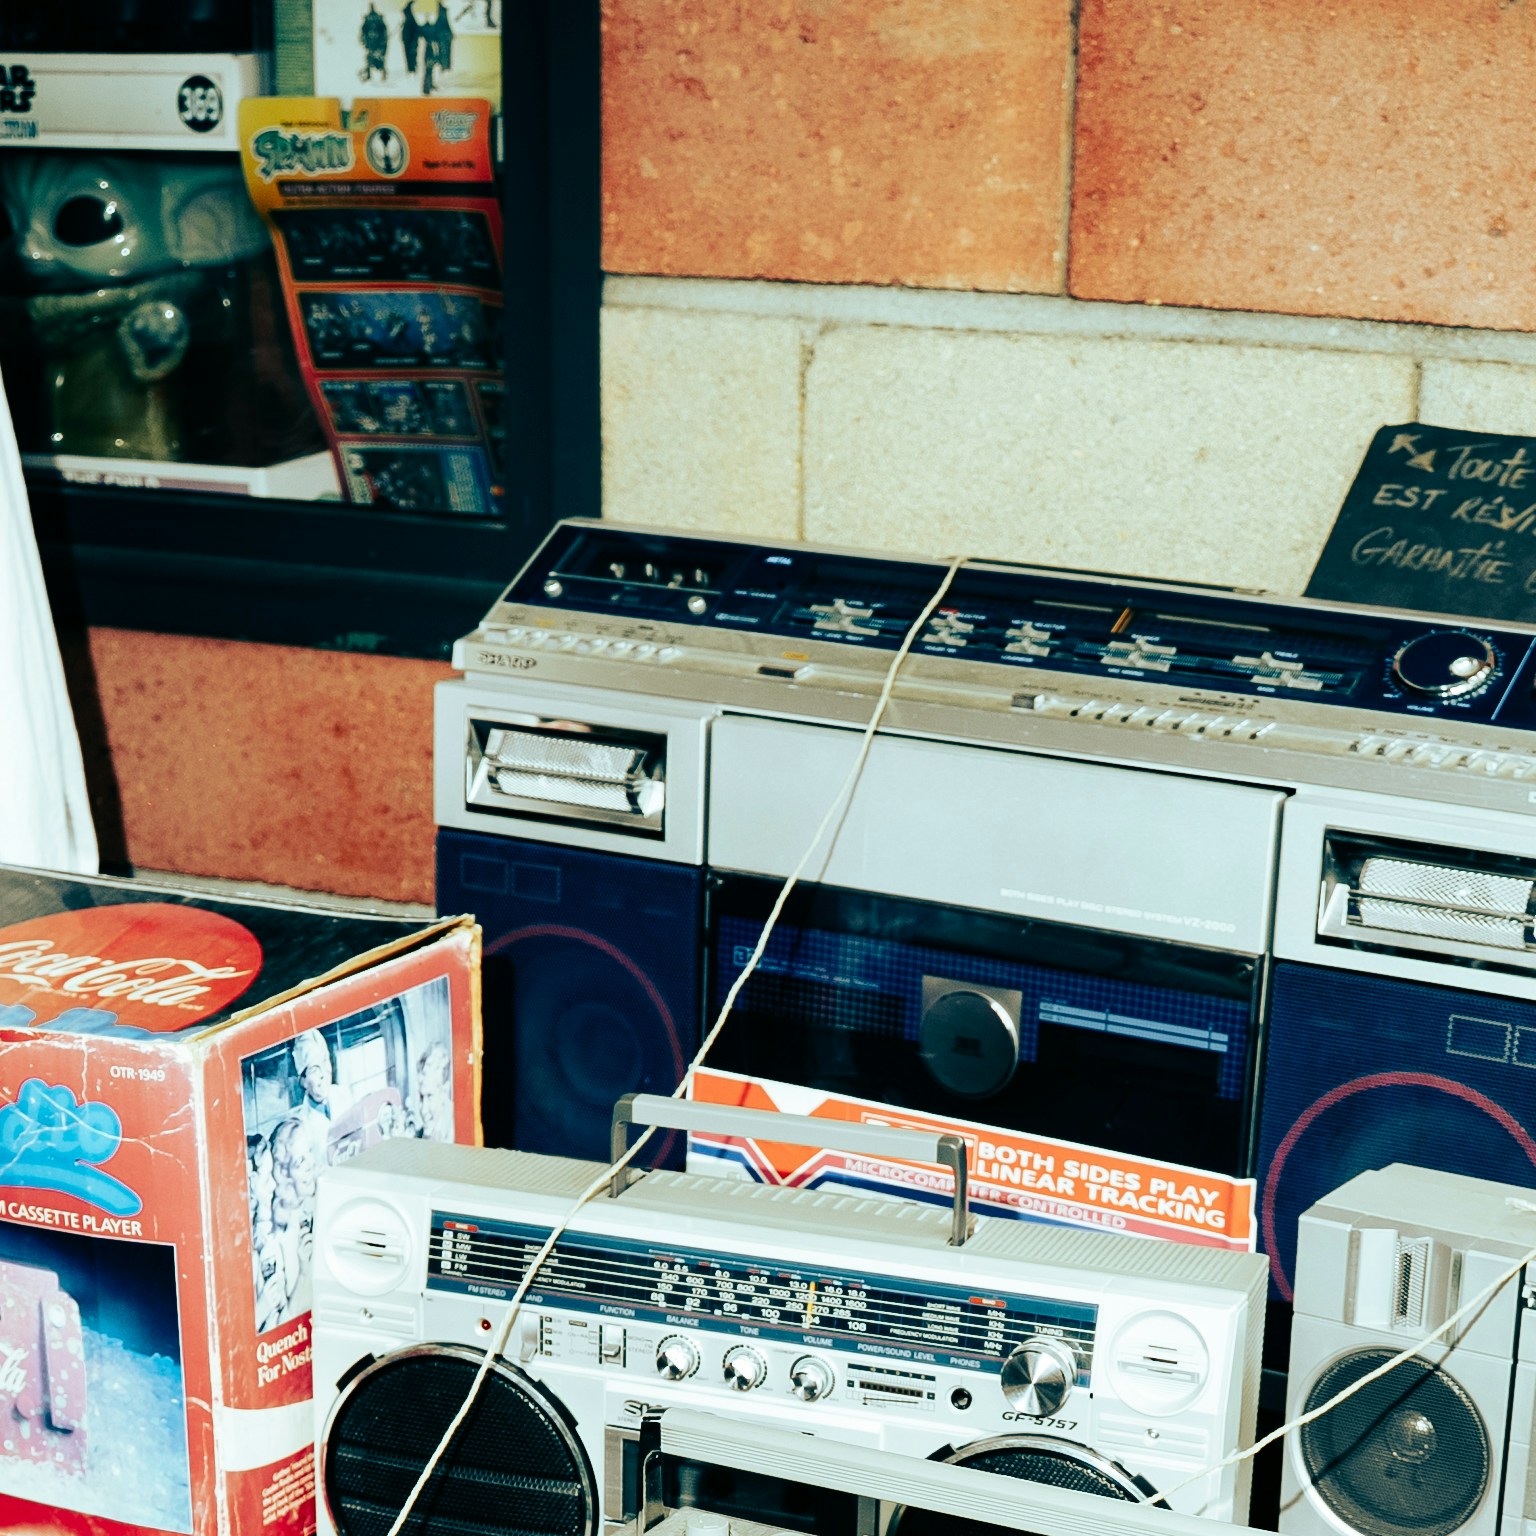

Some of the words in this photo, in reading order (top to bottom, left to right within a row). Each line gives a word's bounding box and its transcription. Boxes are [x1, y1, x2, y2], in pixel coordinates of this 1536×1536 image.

[253, 127, 351, 183] SPAWN
[1372, 483, 1447, 511] EST
[477, 652, 537, 669] SHARP
[109, 1065, 166, 1084] OTR-1949
[978, 1140, 1055, 1172] BOTH
[1063, 1158, 1143, 1191] SIDES
[1149, 1176, 1222, 1208] PLAY
[976, 1159, 1075, 1197] LINEAR
[1083, 1181, 1227, 1229] TRACKING
[8, 1200, 80, 1230] CASSETTE
[81, 1213, 144, 1239] PLAYER
[467, 1284, 479, 1293] FM
[479, 1286, 507, 1298] STEREO
[599, 1304, 636, 1318] FUNCTION
[666, 1314, 700, 1328] BALANCE
[685, 1297, 701, 1308] 92
[761, 1308, 781, 1319] 100
[847, 1321, 867, 1332] 108
[739, 1325, 760, 1336] TONE
[1034, 1325, 1064, 1338] TUNING
[256, 1323, 308, 1364] Quench
[802, 1335, 834, 1348] VOLUME
[857, 1342, 912, 1359] POWER/SOUND
[913, 1350, 937, 1363] LEVEL
[949, 1356, 981, 1369] PHONES
[258, 1364, 281, 1388] For
